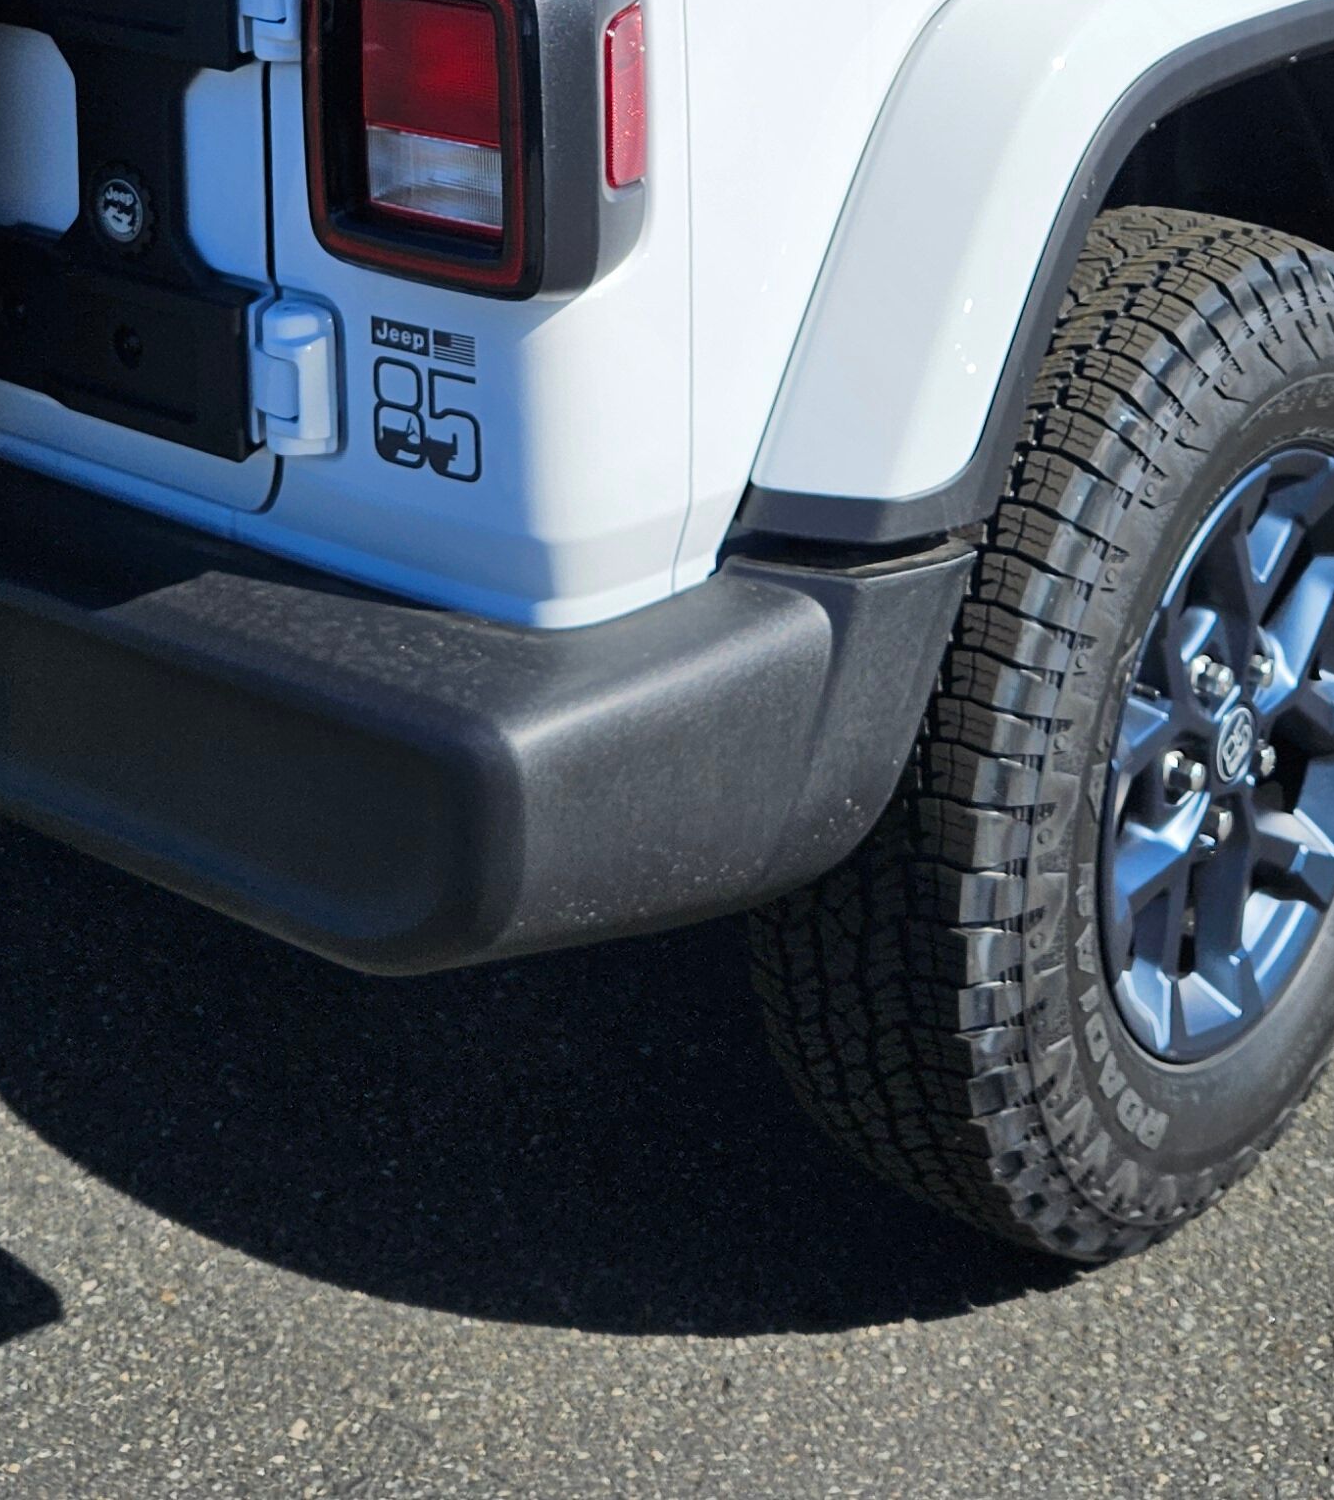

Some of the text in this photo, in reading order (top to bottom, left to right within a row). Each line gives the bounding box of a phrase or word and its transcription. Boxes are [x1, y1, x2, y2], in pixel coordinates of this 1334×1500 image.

[105, 186, 135, 206] Jeep
[375, 321, 425, 349] Jeep
[373, 356, 482, 482] 85
